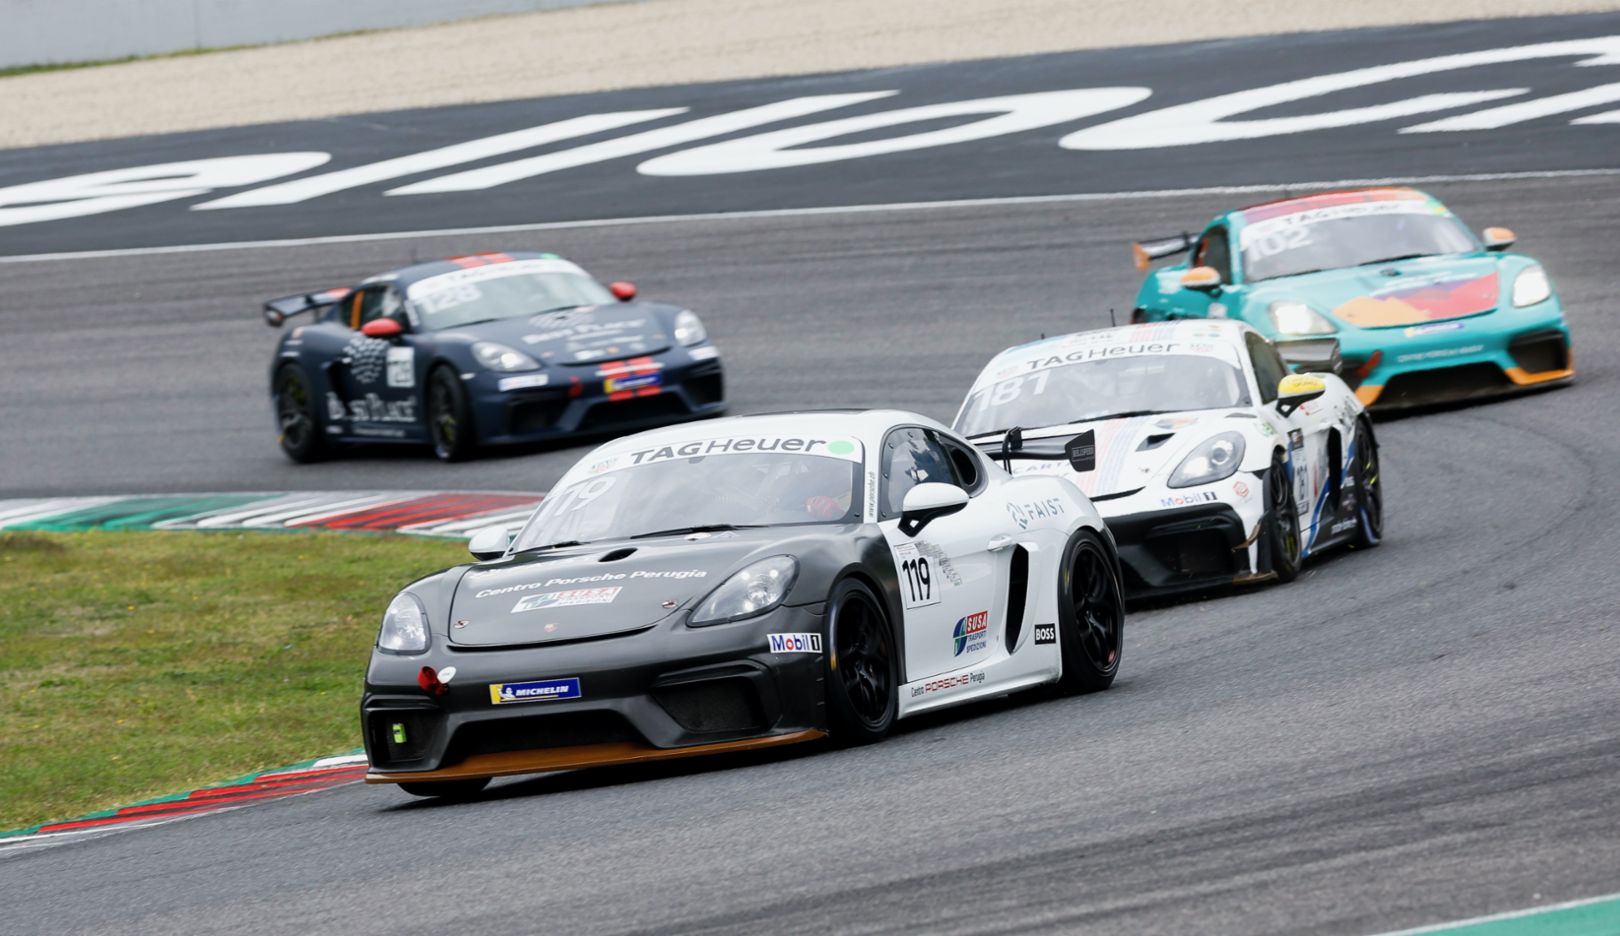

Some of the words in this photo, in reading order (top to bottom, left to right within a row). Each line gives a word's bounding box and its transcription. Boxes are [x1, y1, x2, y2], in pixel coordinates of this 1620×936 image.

[973, 370, 1051, 412] 181
[1024, 497, 1065, 520] FAIST
[1160, 492, 1203, 508] Mobil
[475, 582, 542, 598] Centro
[543, 572, 627, 587] Porsche
[629, 569, 708, 580] Perugia
[902, 557, 931, 602] 119
[967, 613, 987, 633] SUSA
[771, 634, 810, 652] Mobil
[1035, 627, 1055, 641] BOSS
[515, 685, 570, 697] MICHELIN
[911, 686, 925, 698] Centro
[925, 674, 969, 693] PORSCHE
[970, 672, 985, 684] Perugia
